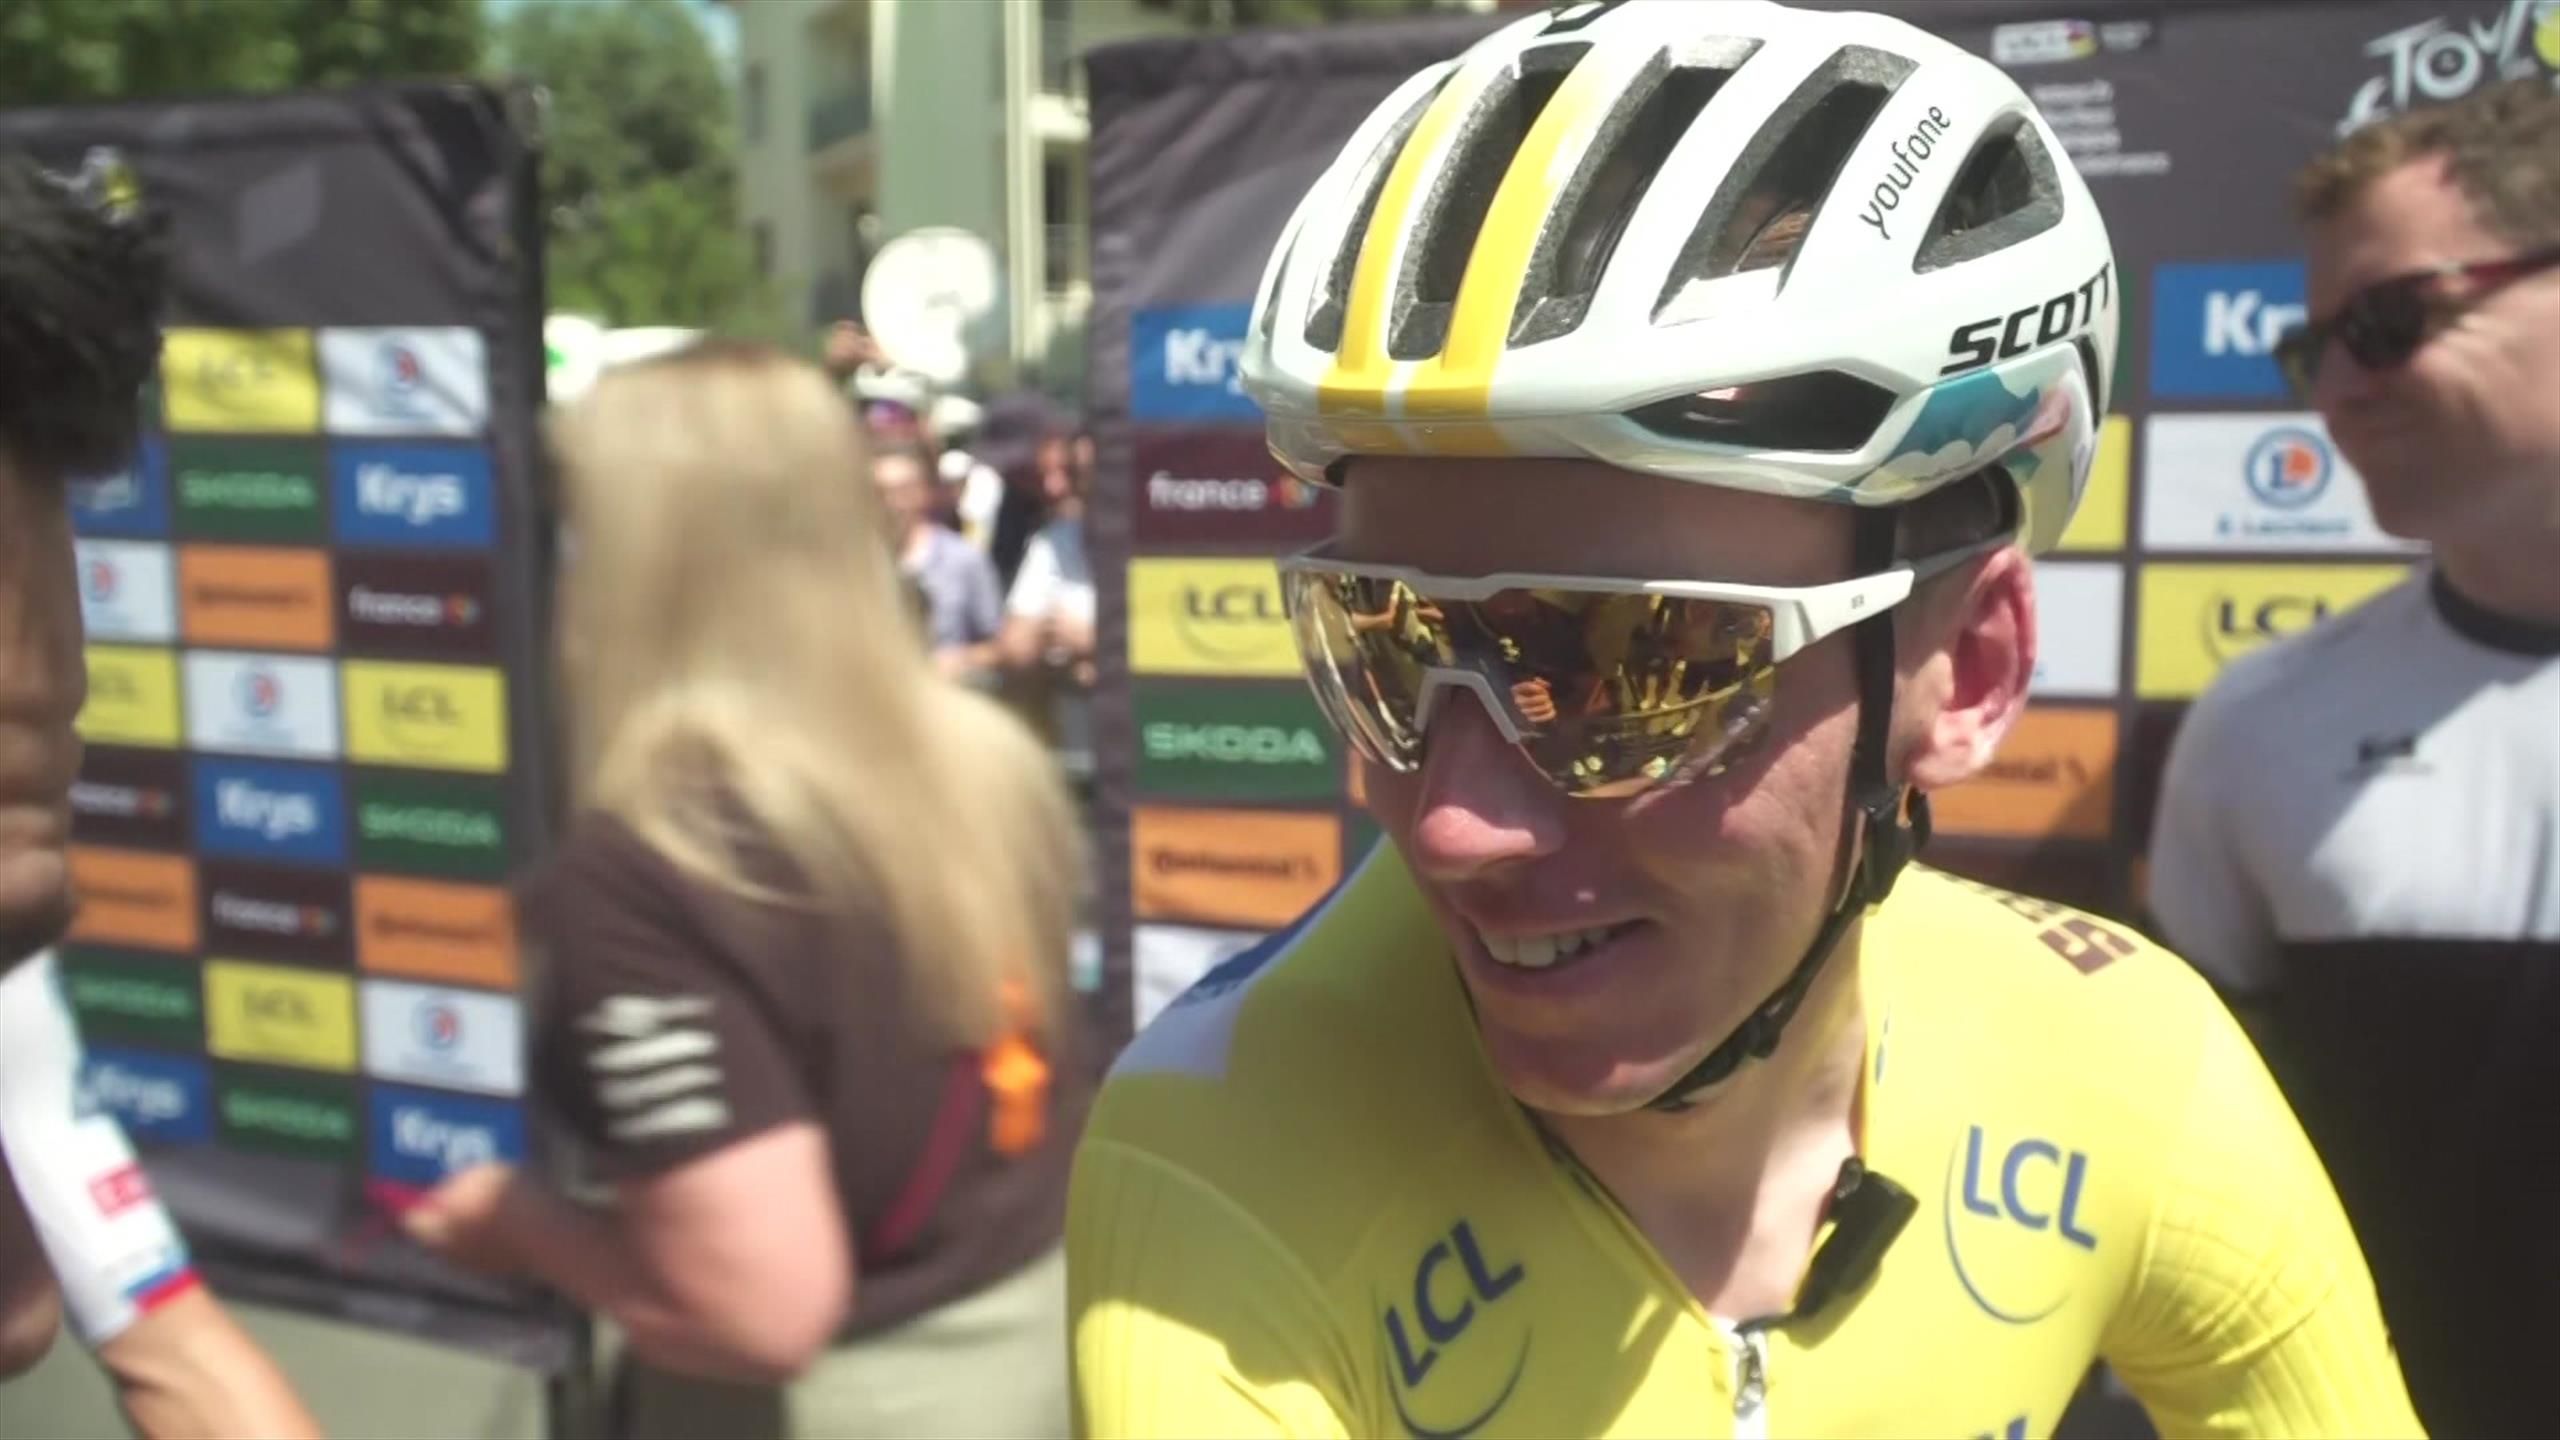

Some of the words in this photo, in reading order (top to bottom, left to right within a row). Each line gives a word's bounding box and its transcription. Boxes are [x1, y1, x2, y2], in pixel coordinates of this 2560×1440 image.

[1859, 106, 1950, 240] youfone
[1940, 262, 2110, 377] SCOTT
[1148, 473, 1266, 509] france
[1963, 1124, 2098, 1252] LCL
[1385, 1219, 1525, 1388] LCL
